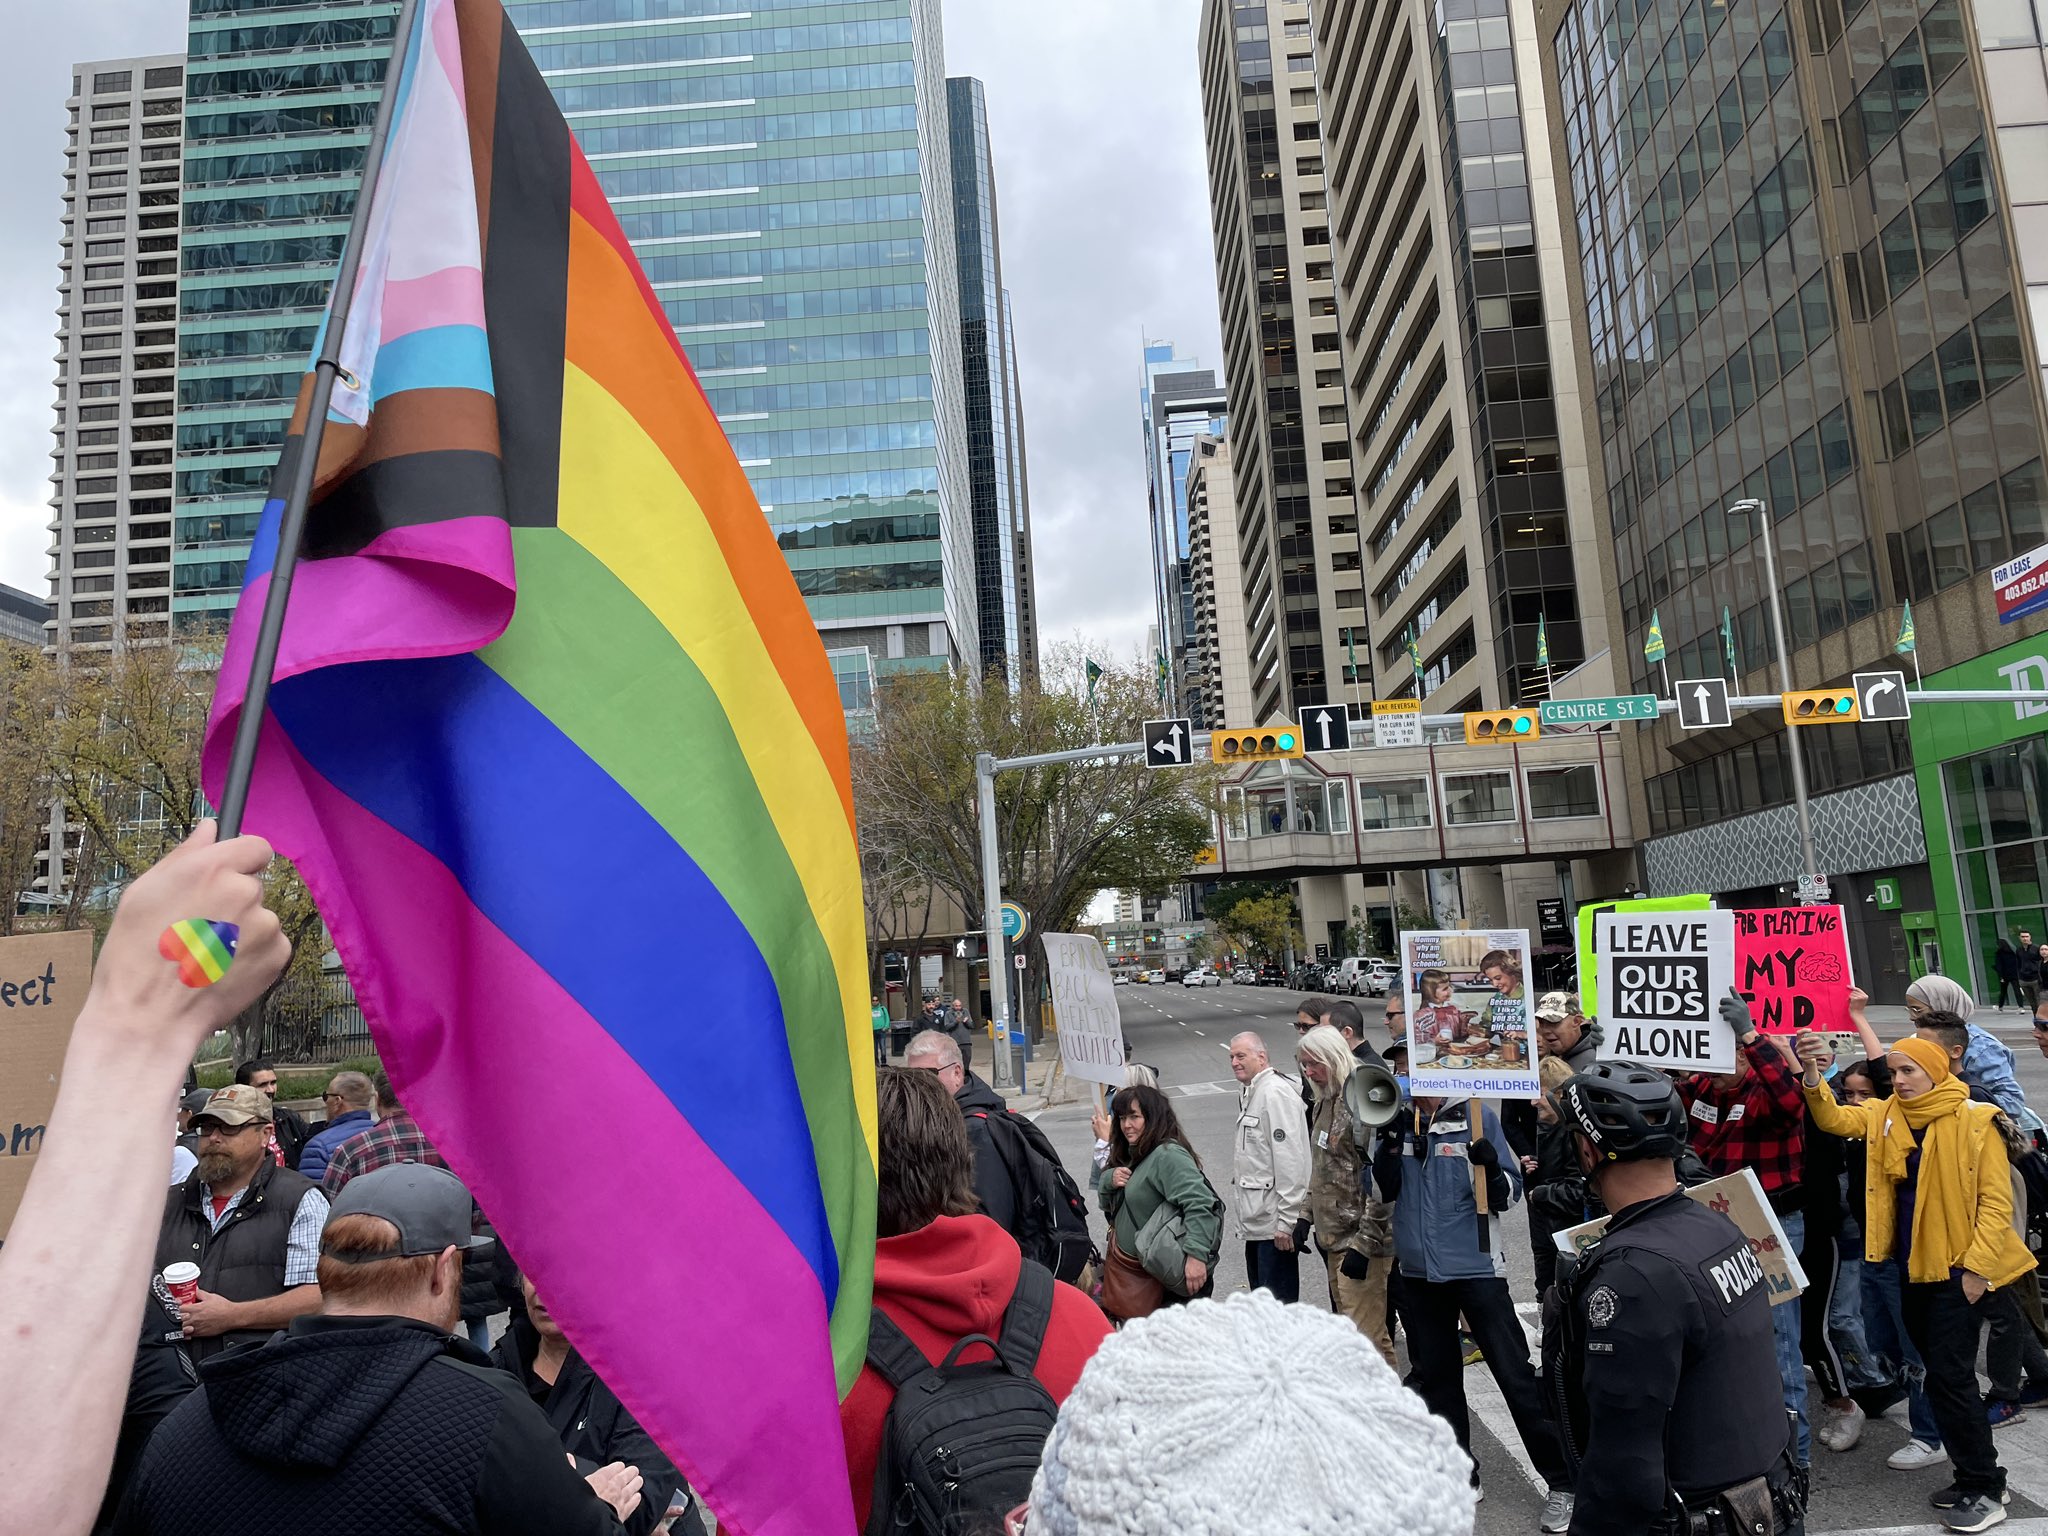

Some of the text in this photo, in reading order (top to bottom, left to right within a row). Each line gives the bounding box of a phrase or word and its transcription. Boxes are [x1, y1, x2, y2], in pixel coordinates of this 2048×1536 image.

[1994, 557, 2031, 583] FOR LEASE
[1998, 655, 2048, 720] TD
[1546, 700, 1653, 719] CENTRE ST S
[1877, 884, 1893, 904] TD
[1763, 910, 1838, 937] PLAYING
[1610, 924, 1708, 952] LEAVE
[1412, 960, 1446, 968] schooled?
[1619, 965, 1699, 990] OUR
[1745, 947, 1804, 990] MY
[0, 961, 56, 1008] ect
[1054, 971, 1095, 1006] BACK
[1490, 998, 1522, 1006] Because
[1620, 990, 1705, 1016] KIDS
[1614, 1026, 1711, 1060] ALONE
[1411, 1078, 1539, 1091] Protect The CHILDREN
[1568, 1083, 1602, 1143] POLICE
[1709, 1244, 1764, 1304] POLICE
